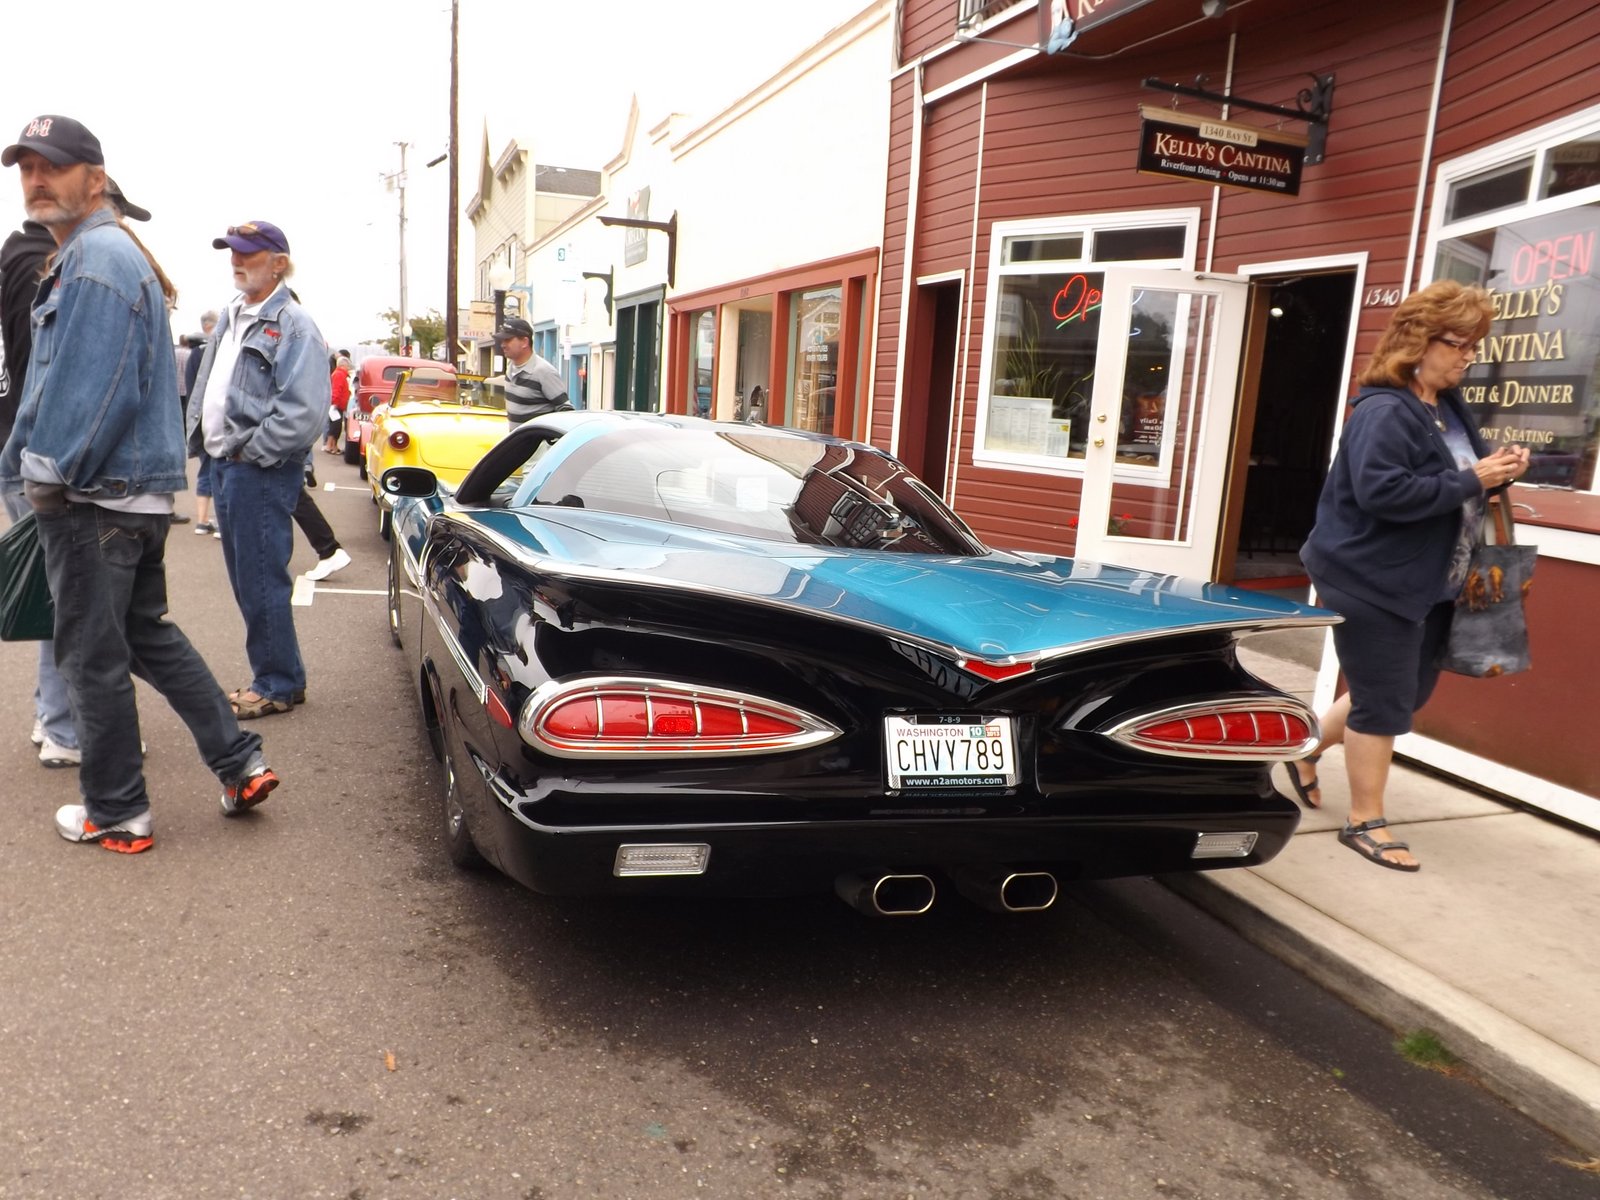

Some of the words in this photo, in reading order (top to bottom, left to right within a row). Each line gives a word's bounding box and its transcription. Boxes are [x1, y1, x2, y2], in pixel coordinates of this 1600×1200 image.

[1204, 125, 1224, 137] 1340
[1226, 128, 1241, 140] BAY
[1154, 132, 1216, 161] KELLY'S
[1219, 144, 1292, 174] CANTINA
[1160, 158, 1197, 173] Riverfront
[1197, 165, 1221, 178] Dining
[1228, 170, 1249, 182] Opens
[1258, 176, 1286, 188] 11:30am
[1512, 230, 1595, 285] OPEN
[1052, 273, 1102, 322] Op
[1365, 288, 1400, 306] 1340
[1486, 279, 1563, 321] ELLY'S
[1468, 329, 1565, 366] ANTINA
[1489, 384, 1501, 403] &
[1501, 380, 1575, 407] DINNER
[1503, 425, 1555, 443] SEATING
[896, 728, 964, 737] WASHINGTON
[938, 716, 961, 724] 7-8-9
[897, 739, 1004, 771] CHVY789
[905, 777, 1003, 786] www.n2amotors.com
